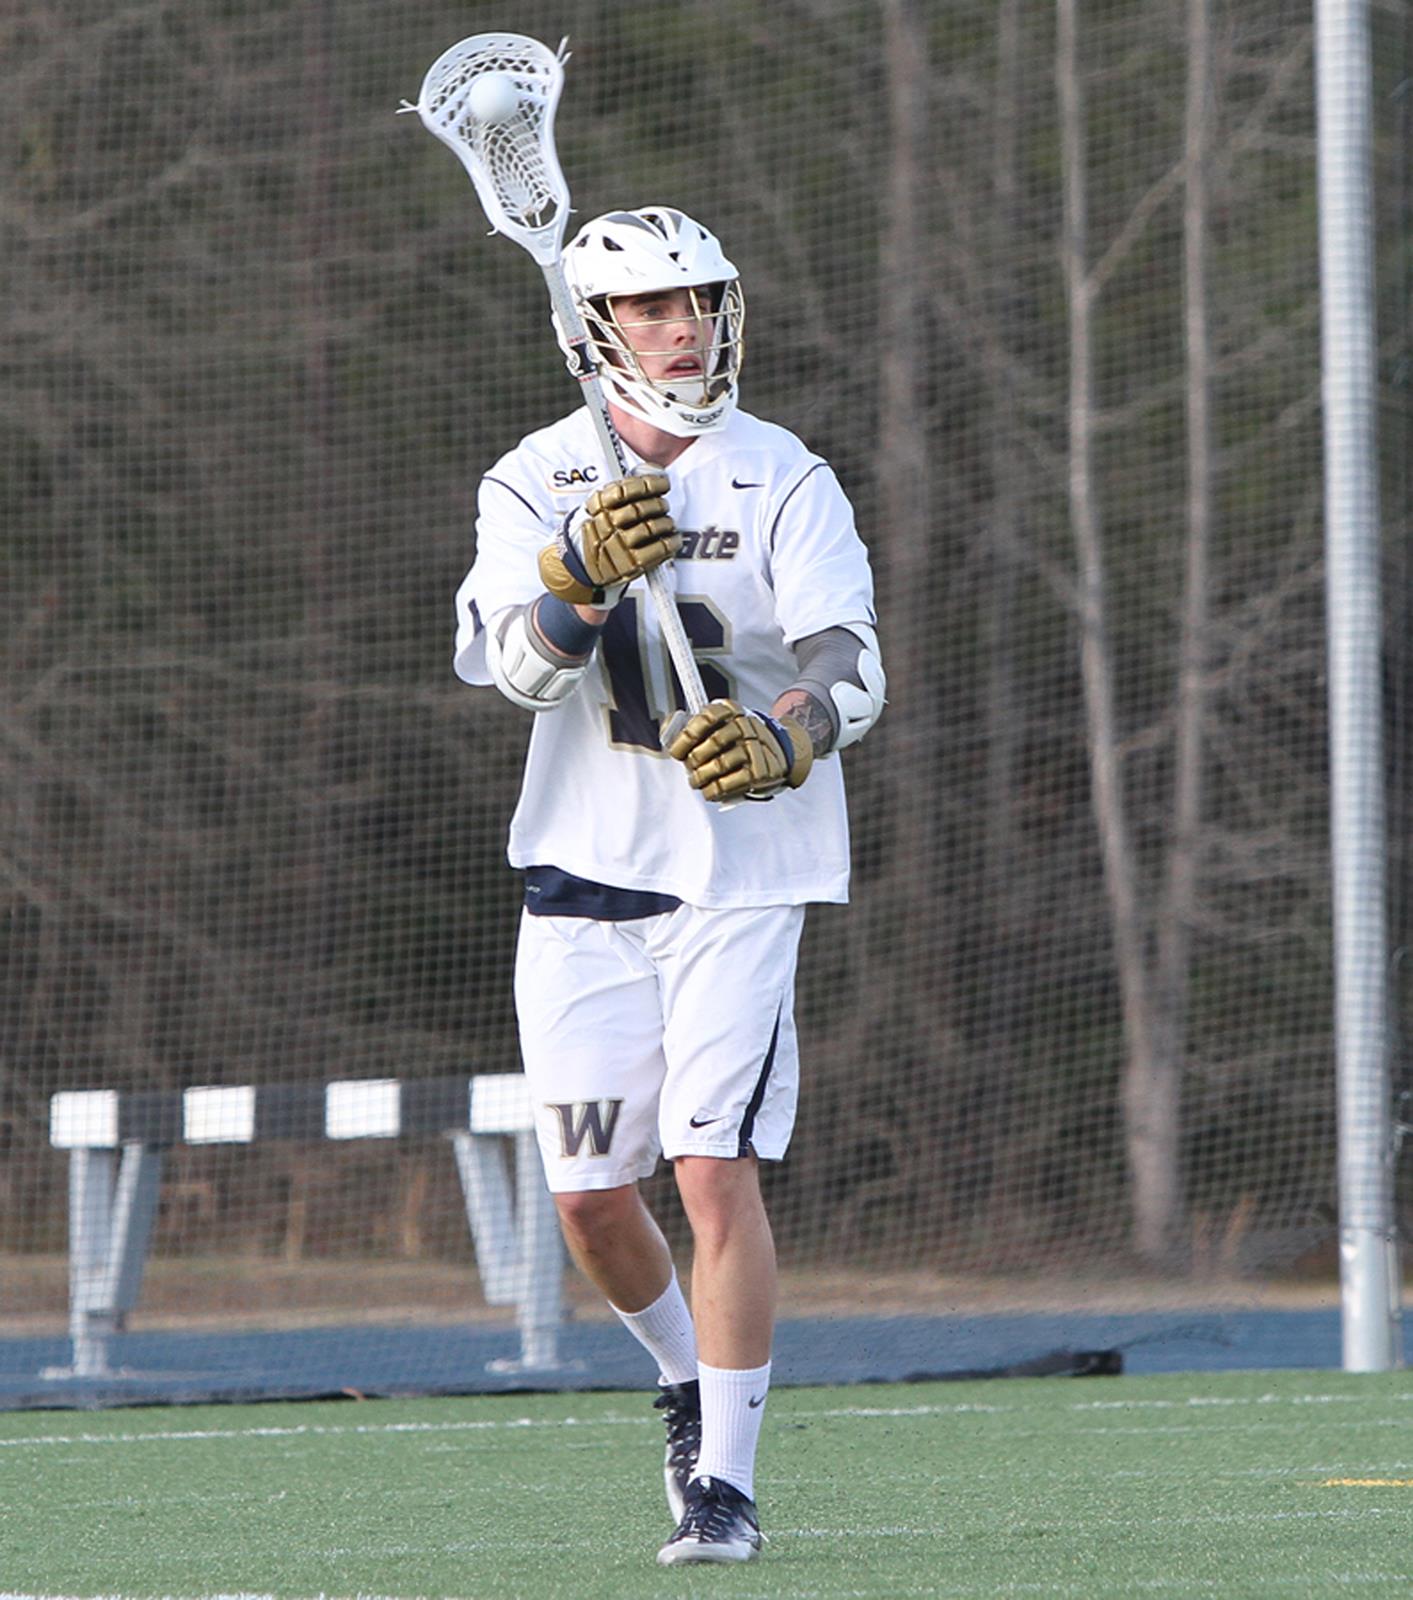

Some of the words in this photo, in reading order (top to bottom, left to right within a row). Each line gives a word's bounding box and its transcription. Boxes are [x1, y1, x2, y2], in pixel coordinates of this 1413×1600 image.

[553, 465, 599, 487] SAC
[674, 524, 740, 561] ate
[597, 589, 738, 760] 16
[543, 1096, 625, 1161] W
